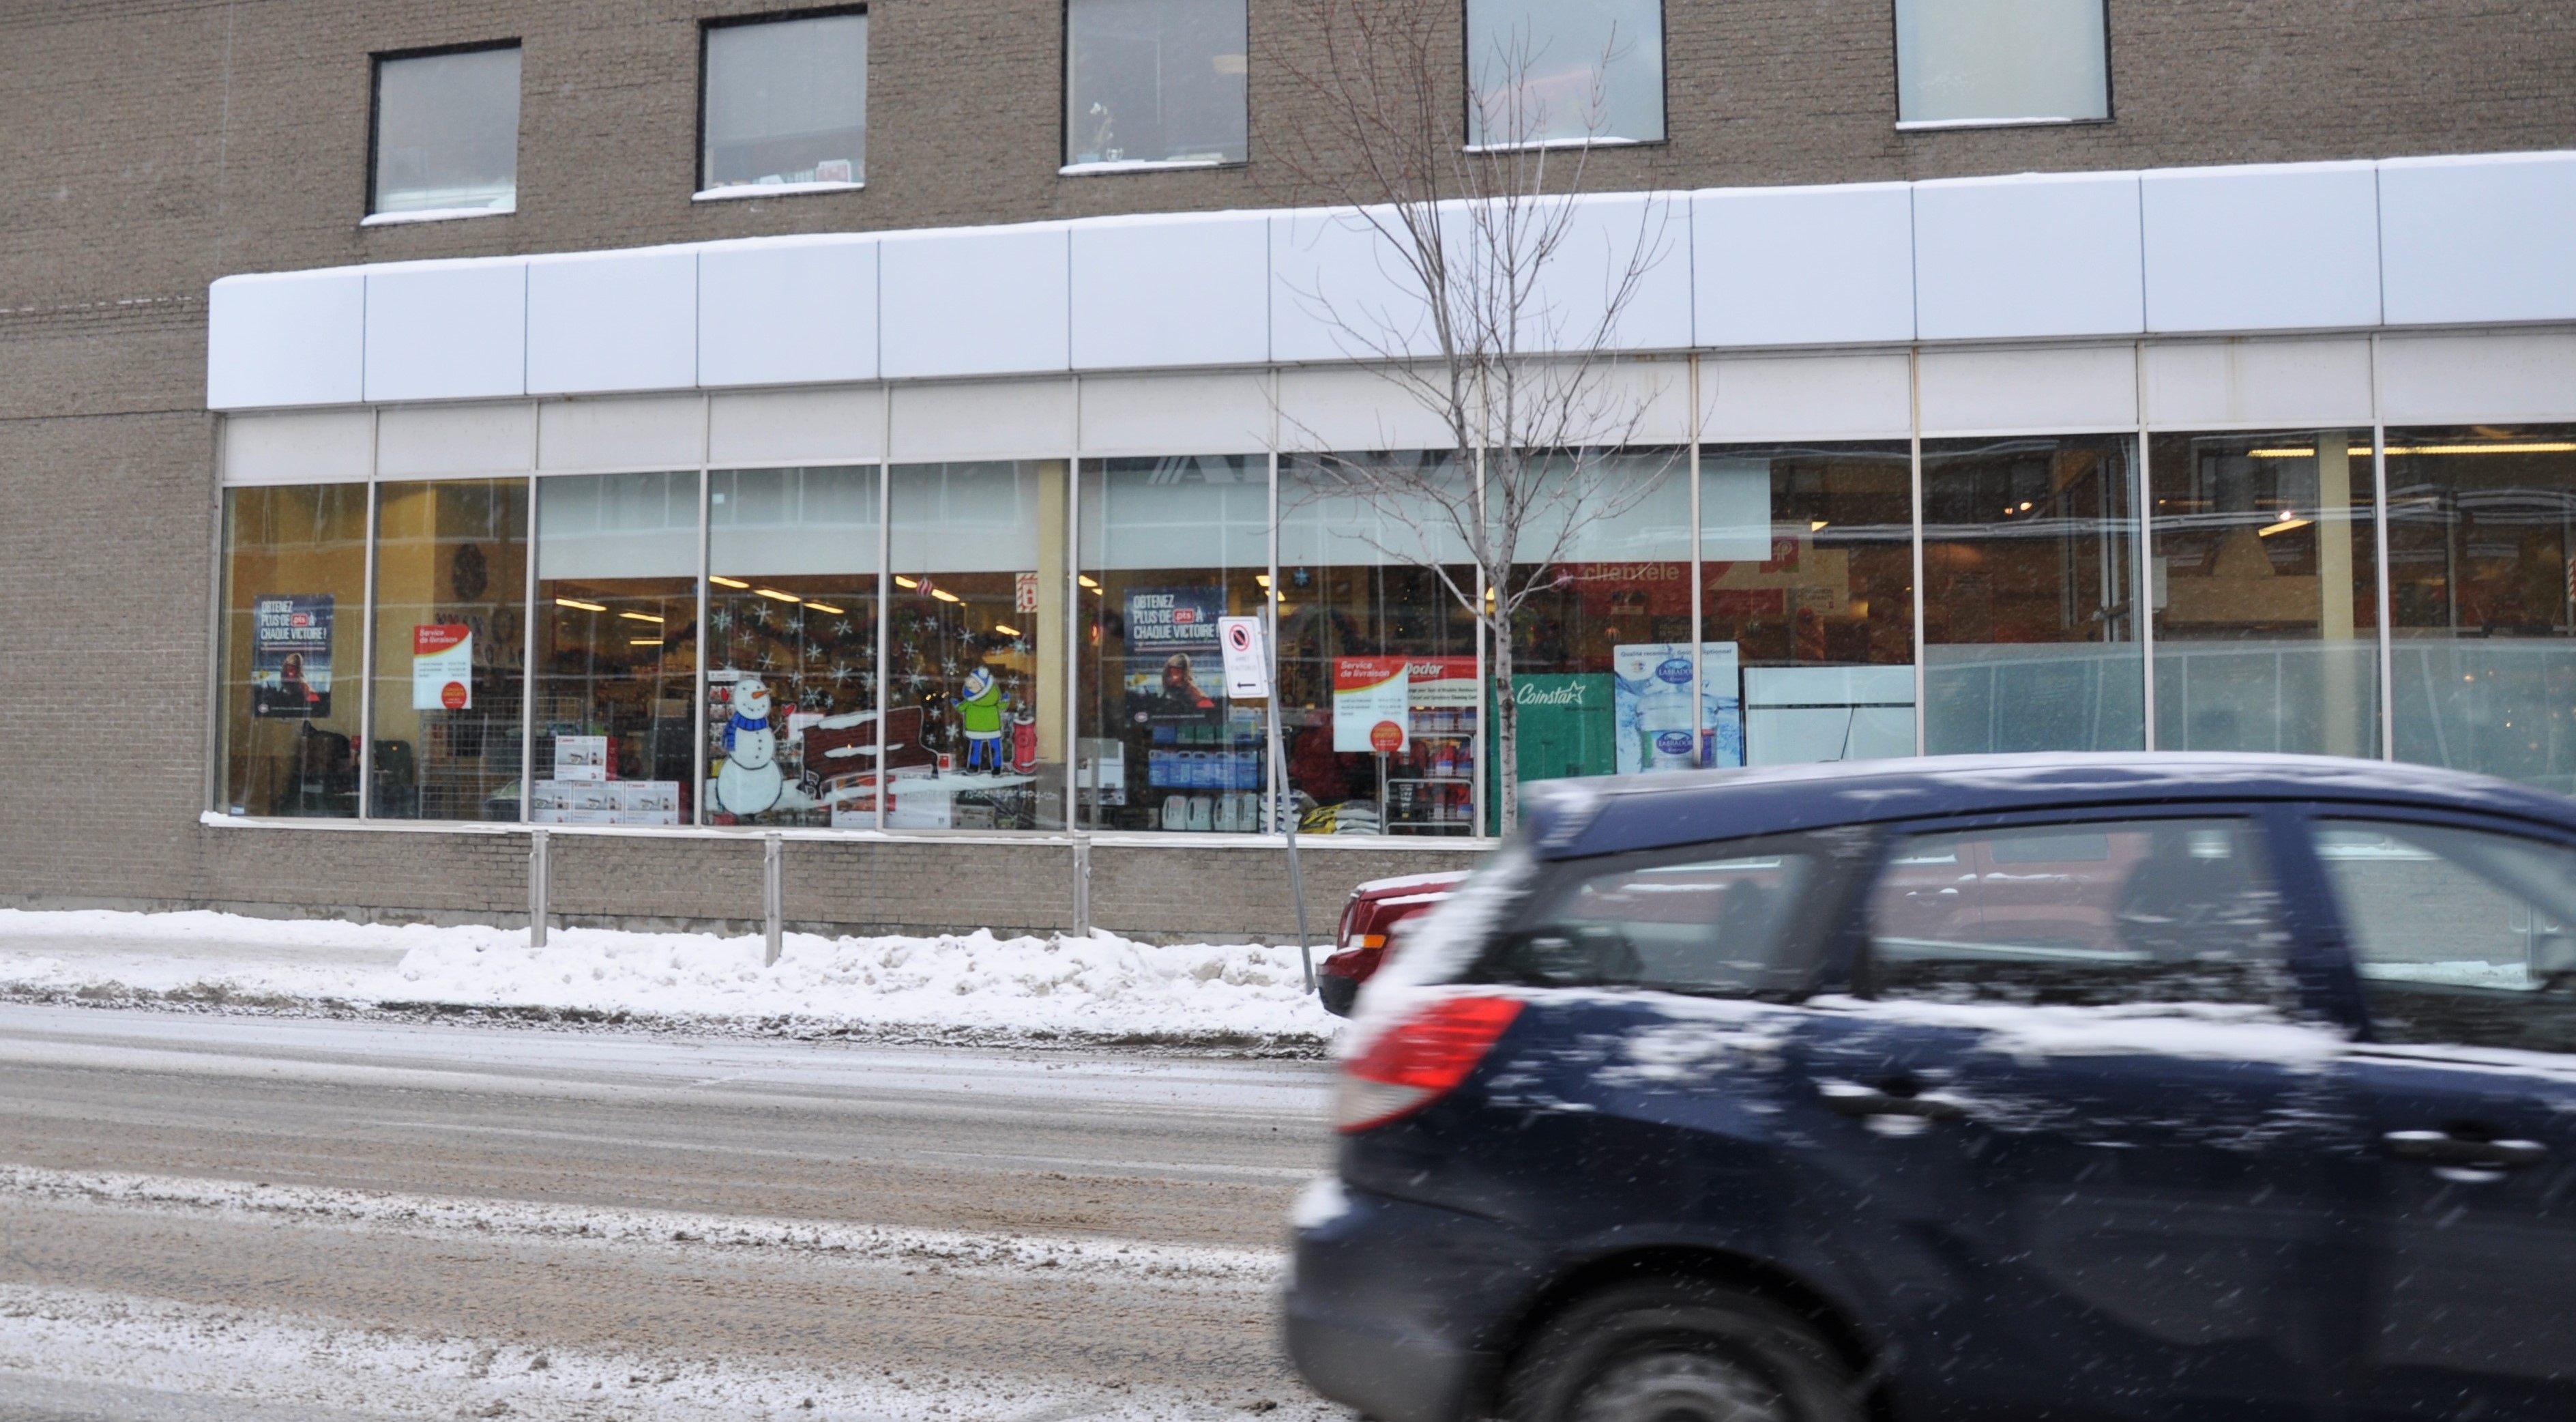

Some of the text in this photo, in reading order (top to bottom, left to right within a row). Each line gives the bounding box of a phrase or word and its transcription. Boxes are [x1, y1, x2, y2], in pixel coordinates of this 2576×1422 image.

[261, 600, 293, 613] OBTENEZ
[1133, 594, 1174, 609] OBTENEZ
[261, 614, 278, 626] PLUS
[280, 614, 290, 626] DE
[1133, 610, 1157, 624] PLUS
[1159, 609, 1172, 624] DE
[261, 628, 290, 640] CHAQUE
[291, 627, 323, 640] VICTOIRE
[1134, 624, 1172, 639] CHAQUE
[1173, 623, 1214, 639] VICTOIRE
[1341, 661, 1373, 670] Service
[1341, 669, 1390, 678] de livraison
[1517, 682, 1577, 704] Coinstar
